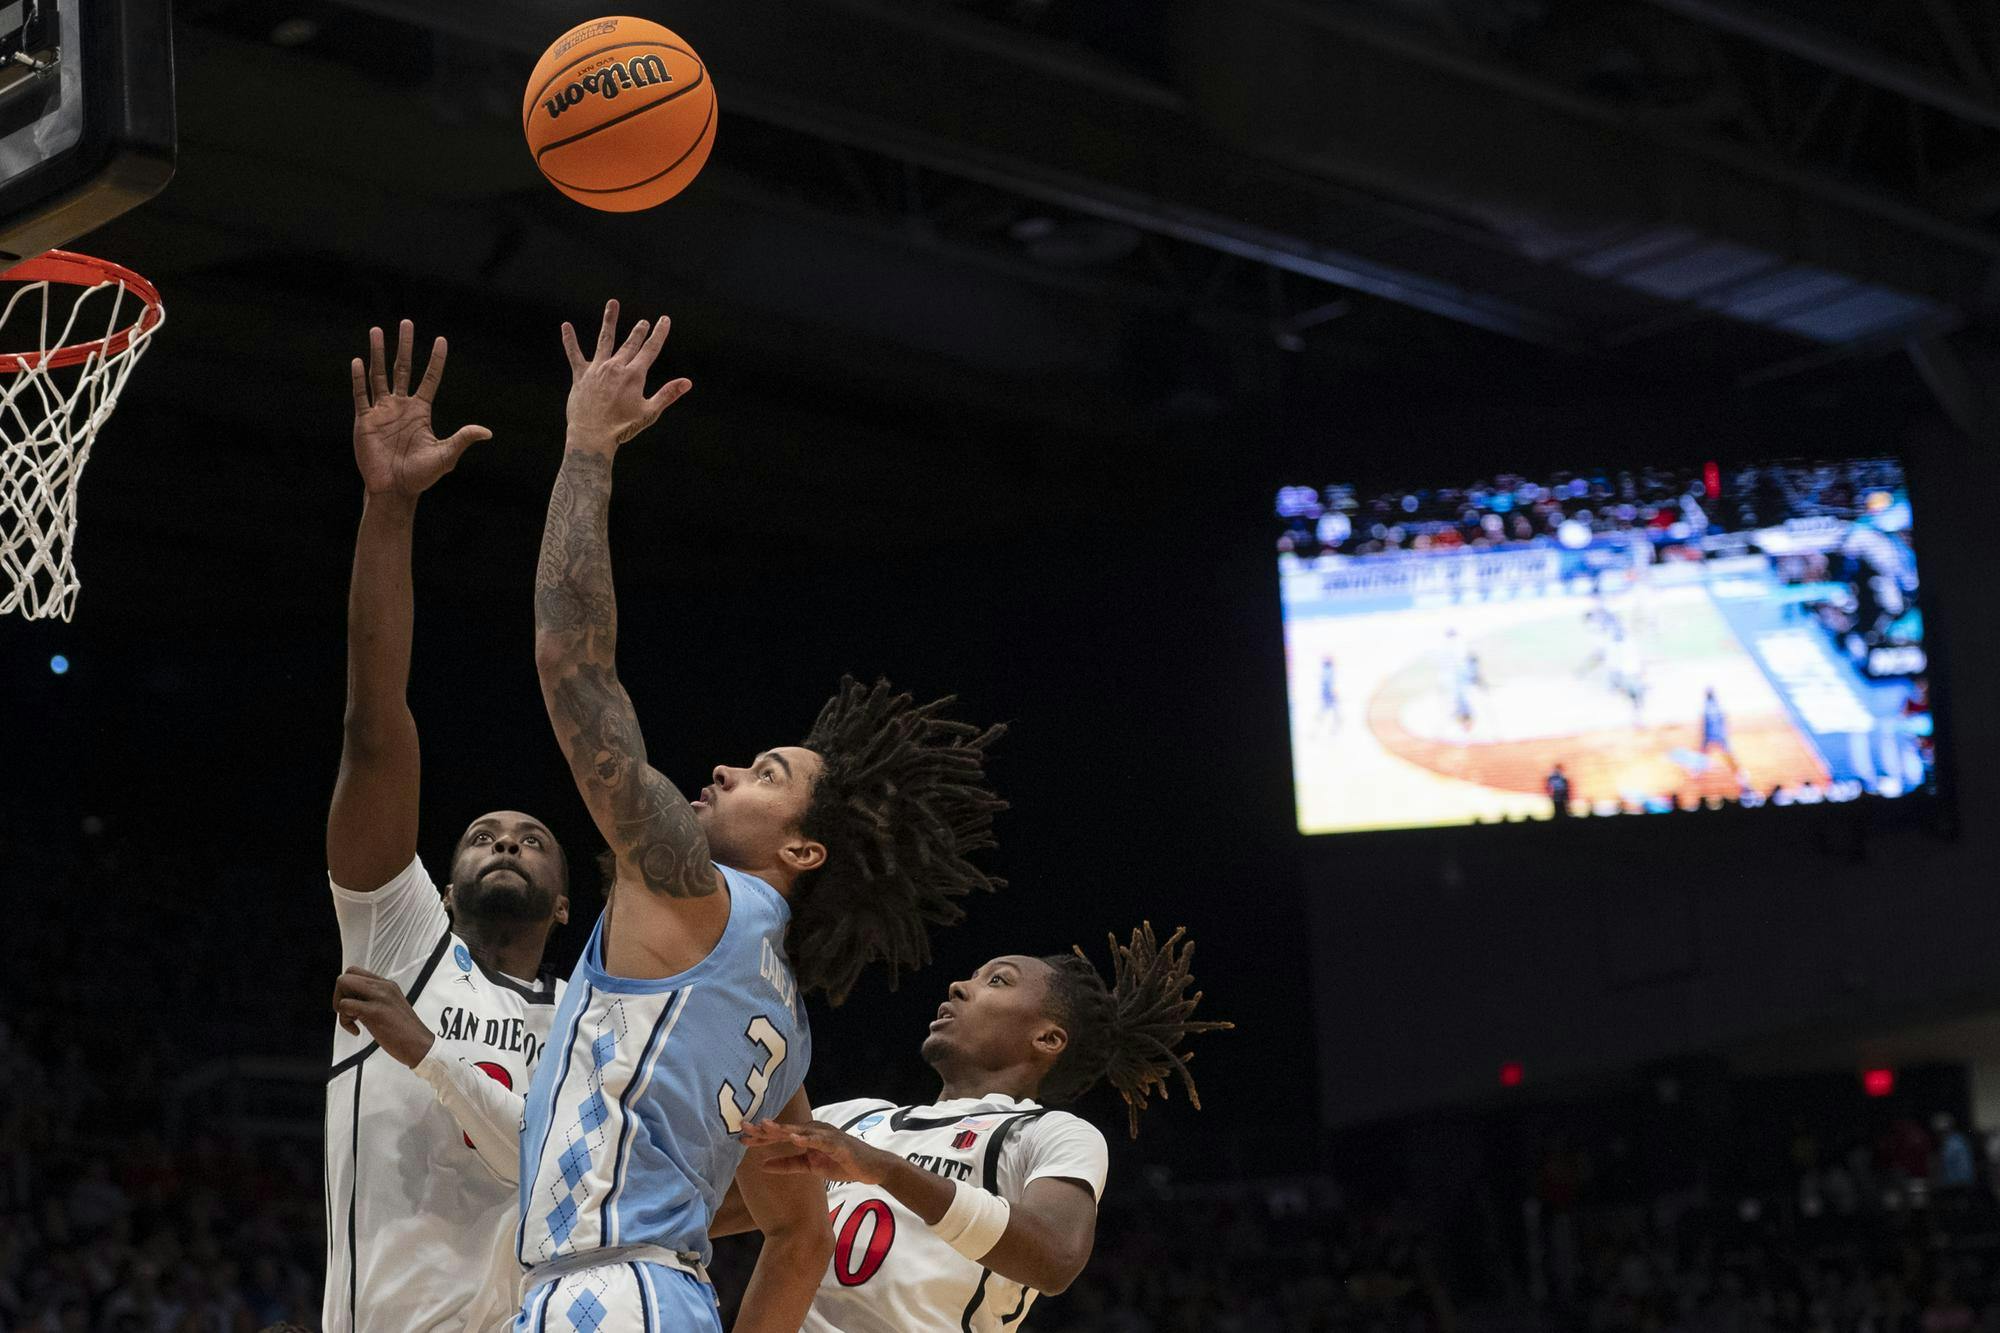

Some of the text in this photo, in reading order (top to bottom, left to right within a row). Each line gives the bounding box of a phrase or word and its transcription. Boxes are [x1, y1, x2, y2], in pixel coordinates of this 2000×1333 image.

[541, 53, 673, 119] Wilson
[437, 1006, 480, 1042] SAN
[717, 1015, 788, 1134] 3
[829, 1198, 896, 1287] 0
